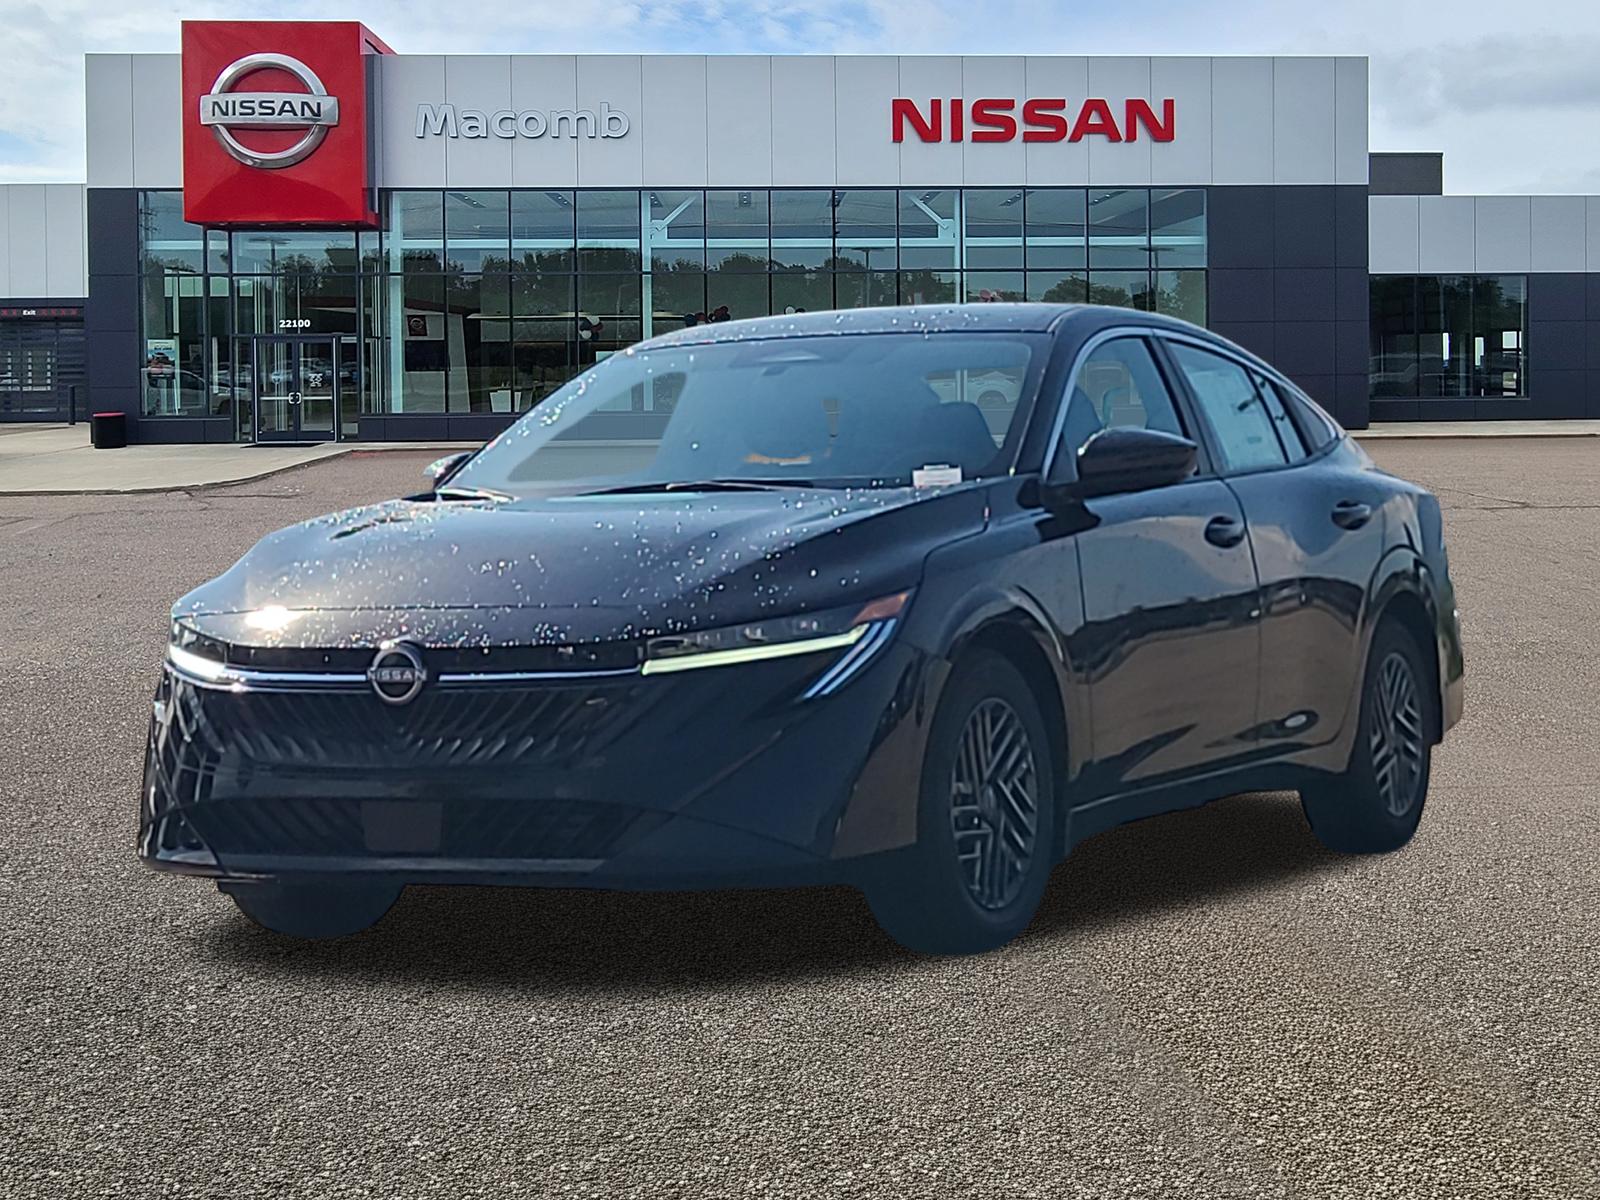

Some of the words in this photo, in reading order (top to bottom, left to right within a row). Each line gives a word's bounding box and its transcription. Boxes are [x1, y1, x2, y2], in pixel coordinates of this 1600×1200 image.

[212, 100, 321, 117] NISSAN
[415, 102, 630, 138] Macomb
[892, 98, 1175, 142] NISSAN
[279, 319, 311, 328] 22100
[367, 668, 427, 681] NISSAN
